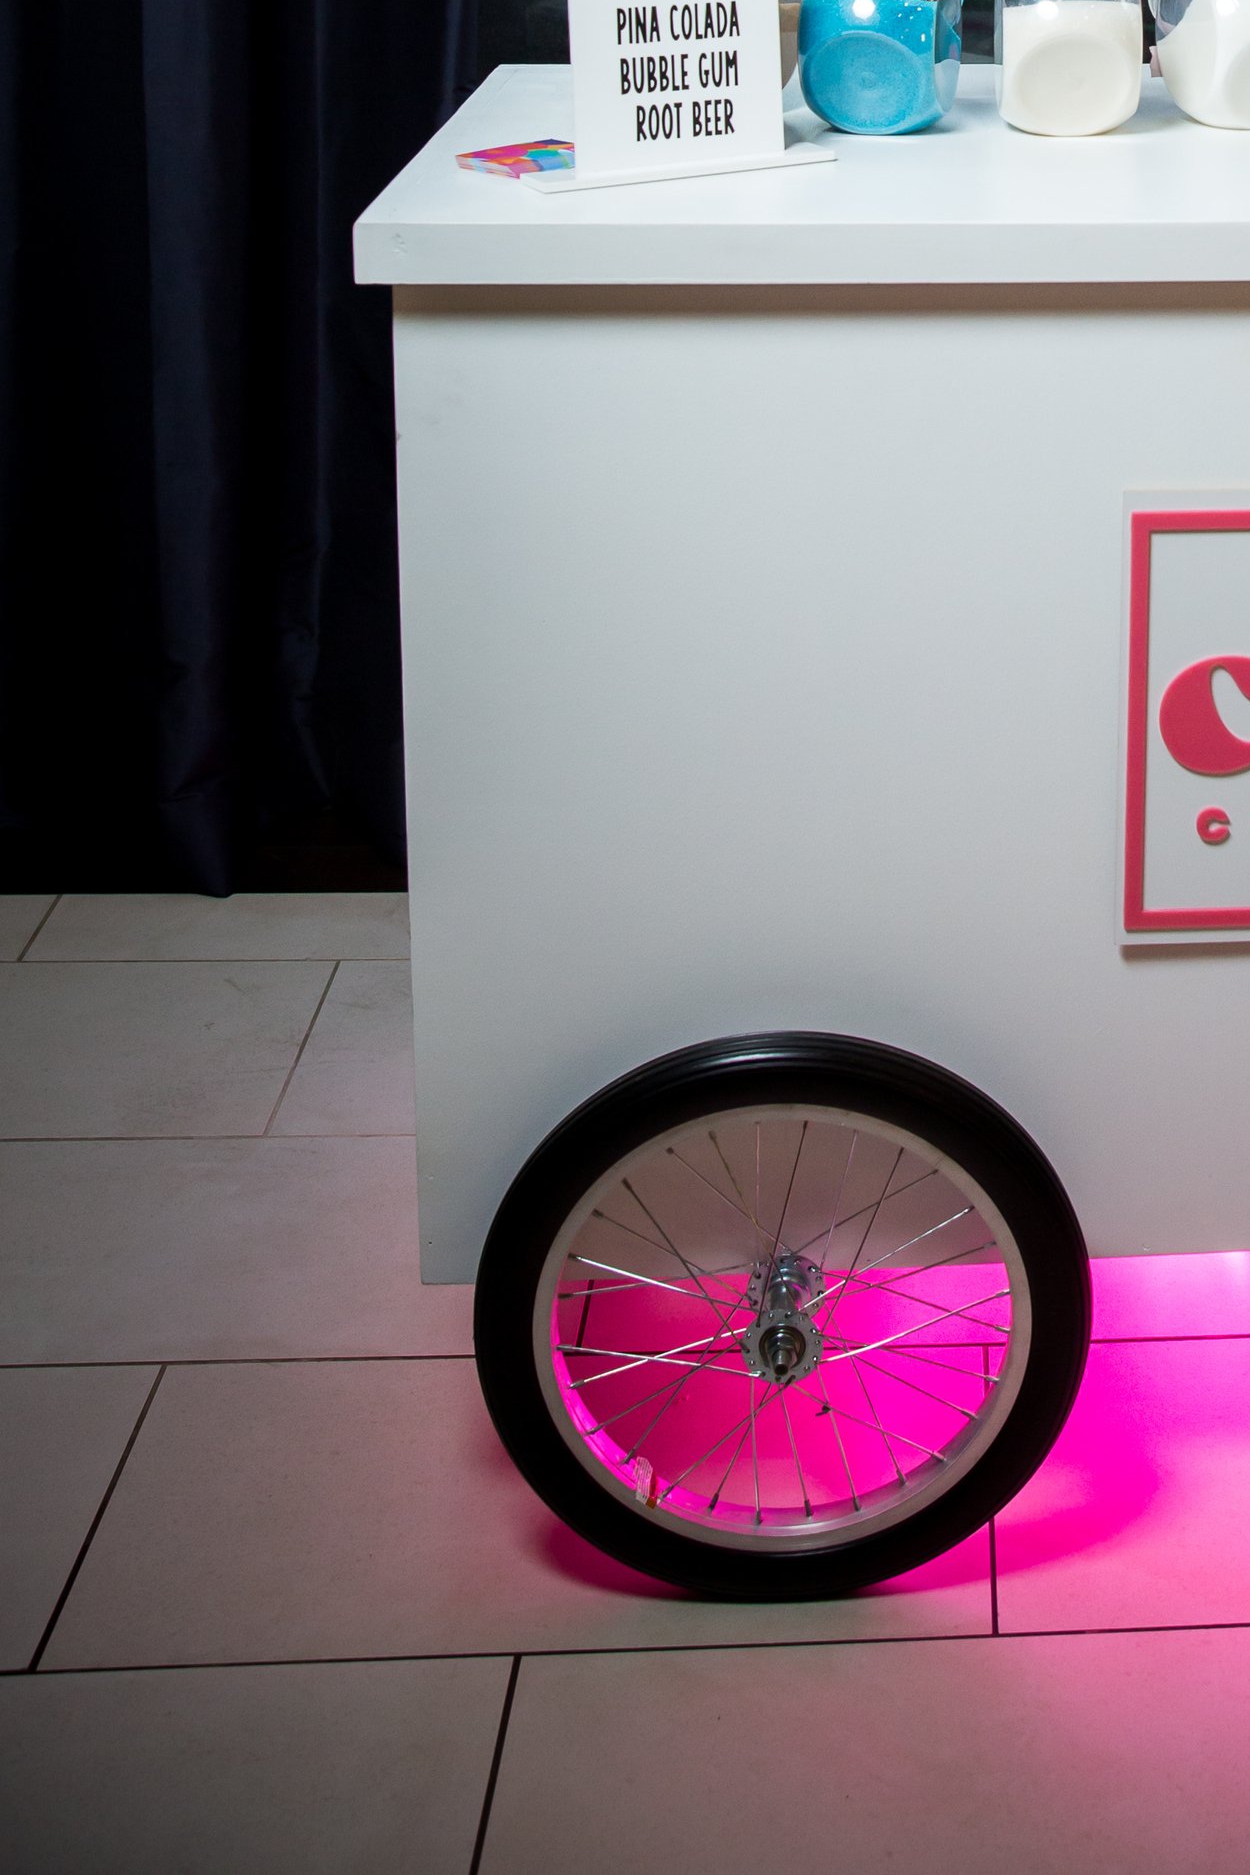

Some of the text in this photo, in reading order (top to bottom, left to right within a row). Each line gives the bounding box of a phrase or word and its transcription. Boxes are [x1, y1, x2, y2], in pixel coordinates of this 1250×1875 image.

[617, 1, 740, 45] PINA COLADA
[621, 51, 739, 95] BUBBLE GUM
[637, 99, 736, 142] ROOT BEER
